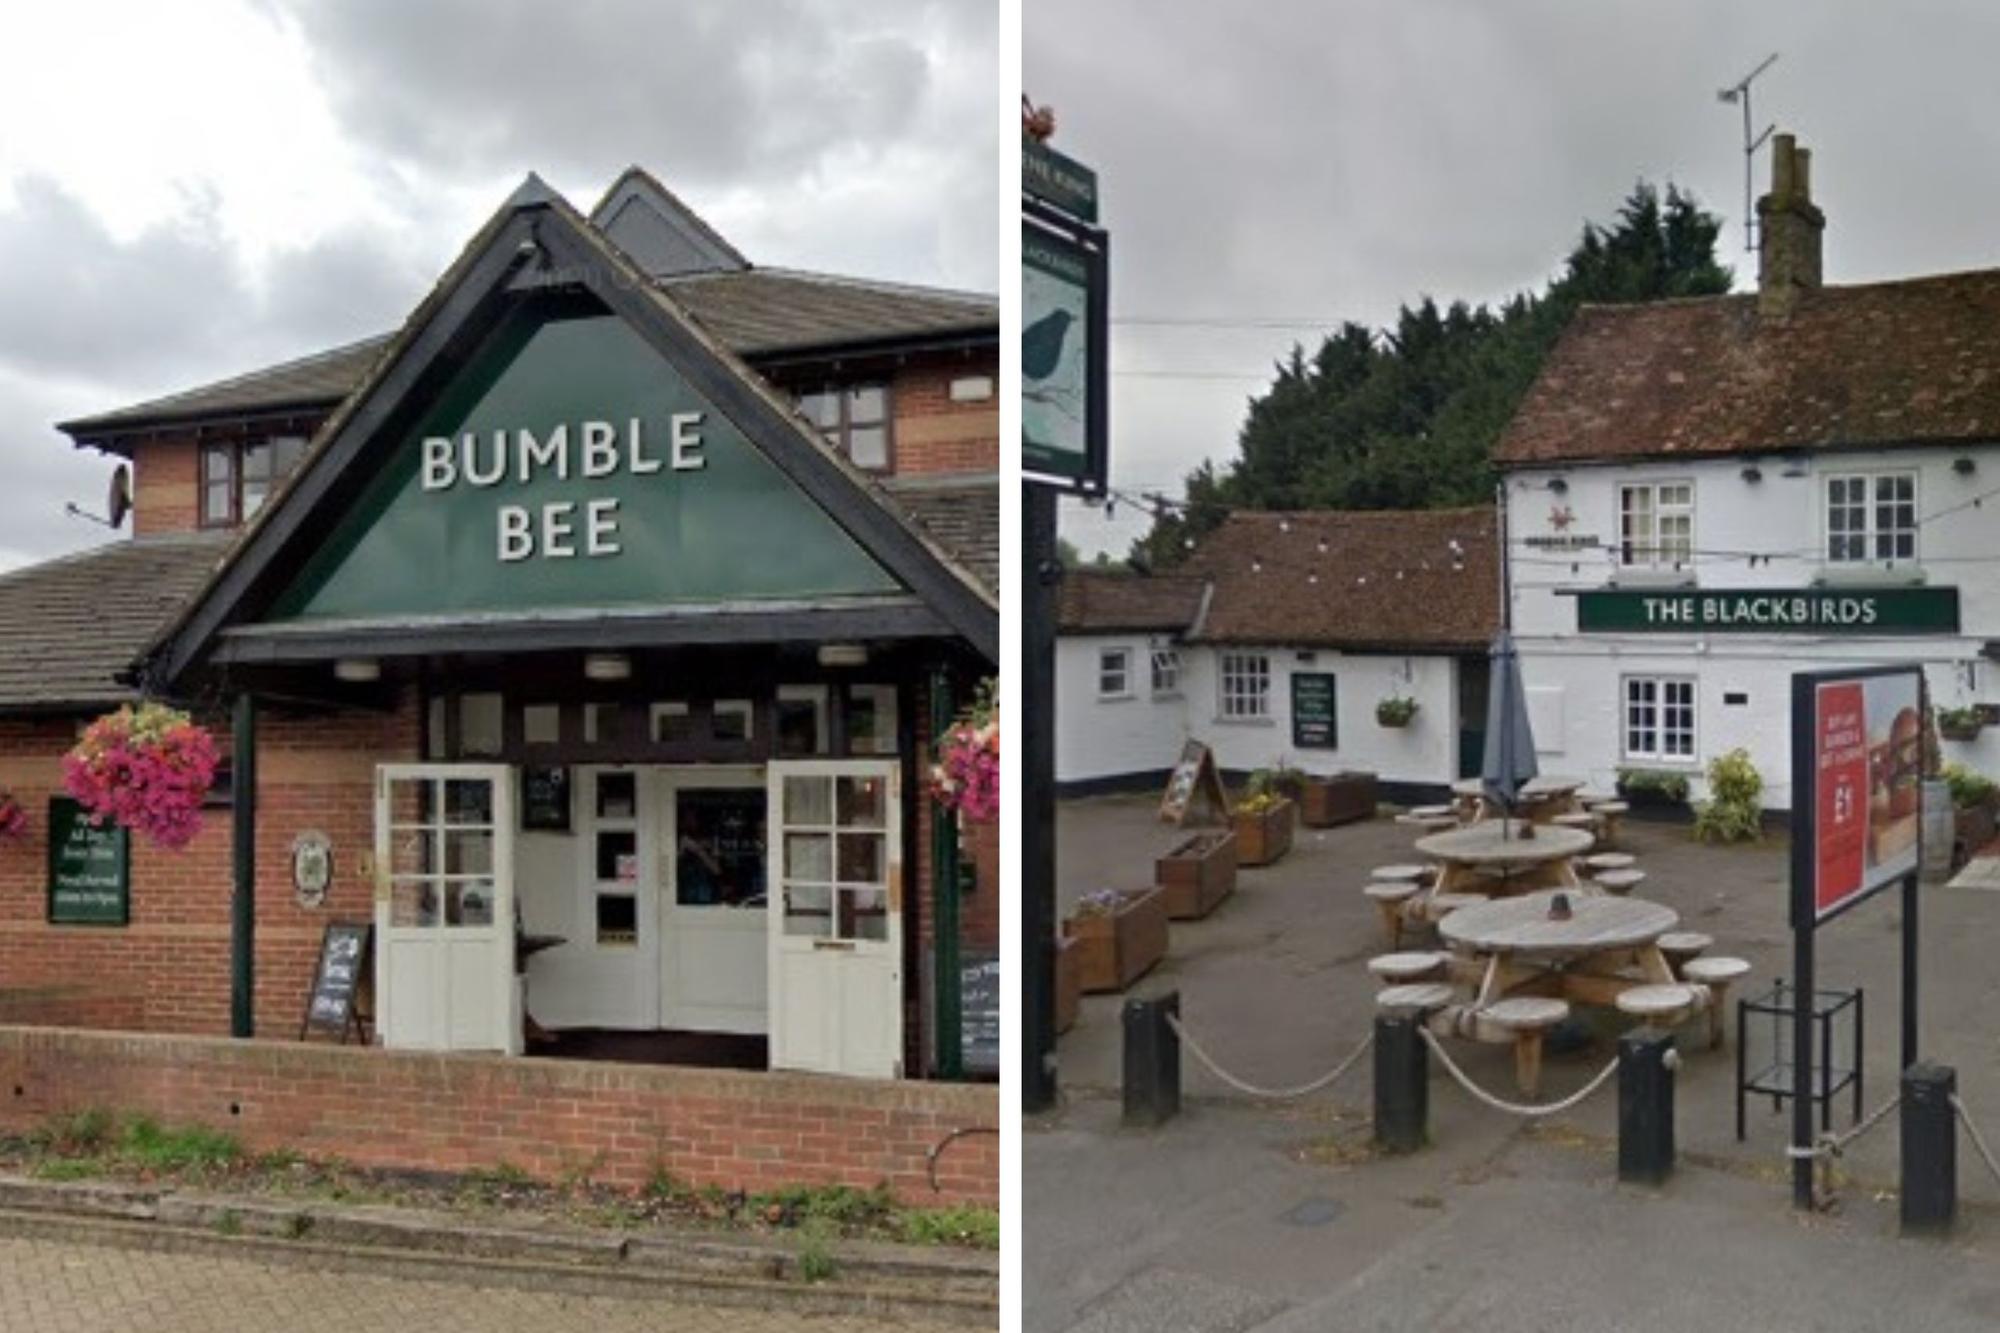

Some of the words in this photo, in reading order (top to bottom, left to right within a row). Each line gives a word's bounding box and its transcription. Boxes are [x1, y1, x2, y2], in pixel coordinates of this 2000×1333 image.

[421, 412, 705, 491] BUMBLE
[496, 497, 622, 561] BEE
[1642, 598, 1695, 622] THE
[1701, 598, 1878, 624] BLACKBIRDS
